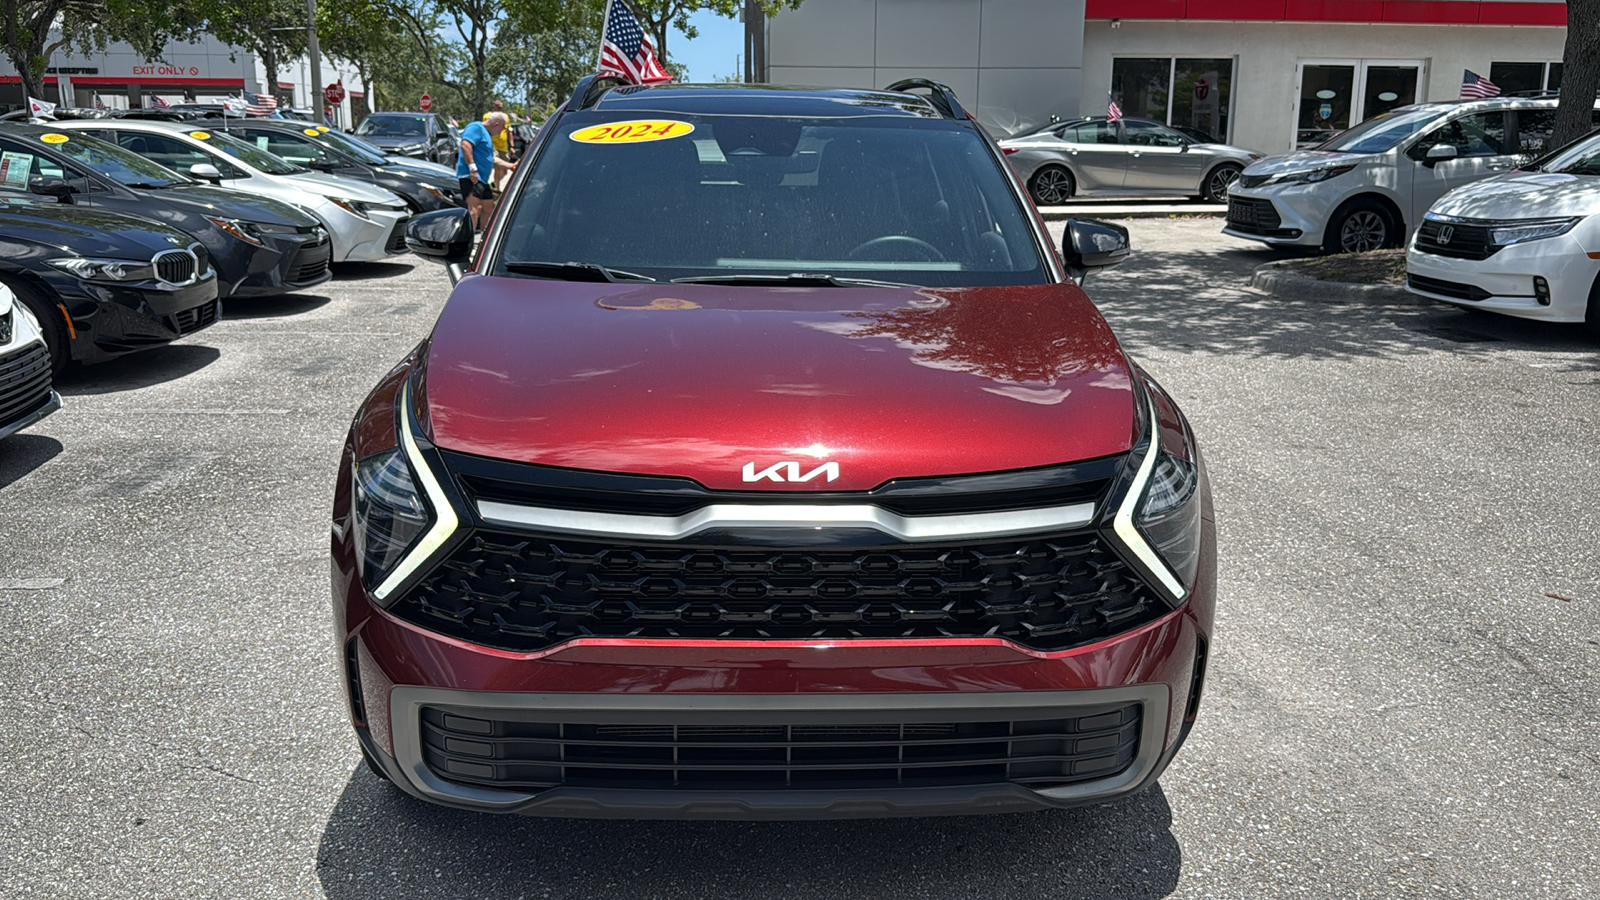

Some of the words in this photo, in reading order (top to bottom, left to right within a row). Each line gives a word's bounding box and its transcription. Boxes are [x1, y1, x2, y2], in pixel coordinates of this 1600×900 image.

[132, 66, 155, 75] EXIT
[157, 66, 186, 75] ONLY
[588, 122, 676, 140] 2024
[742, 461, 840, 483] KIA
